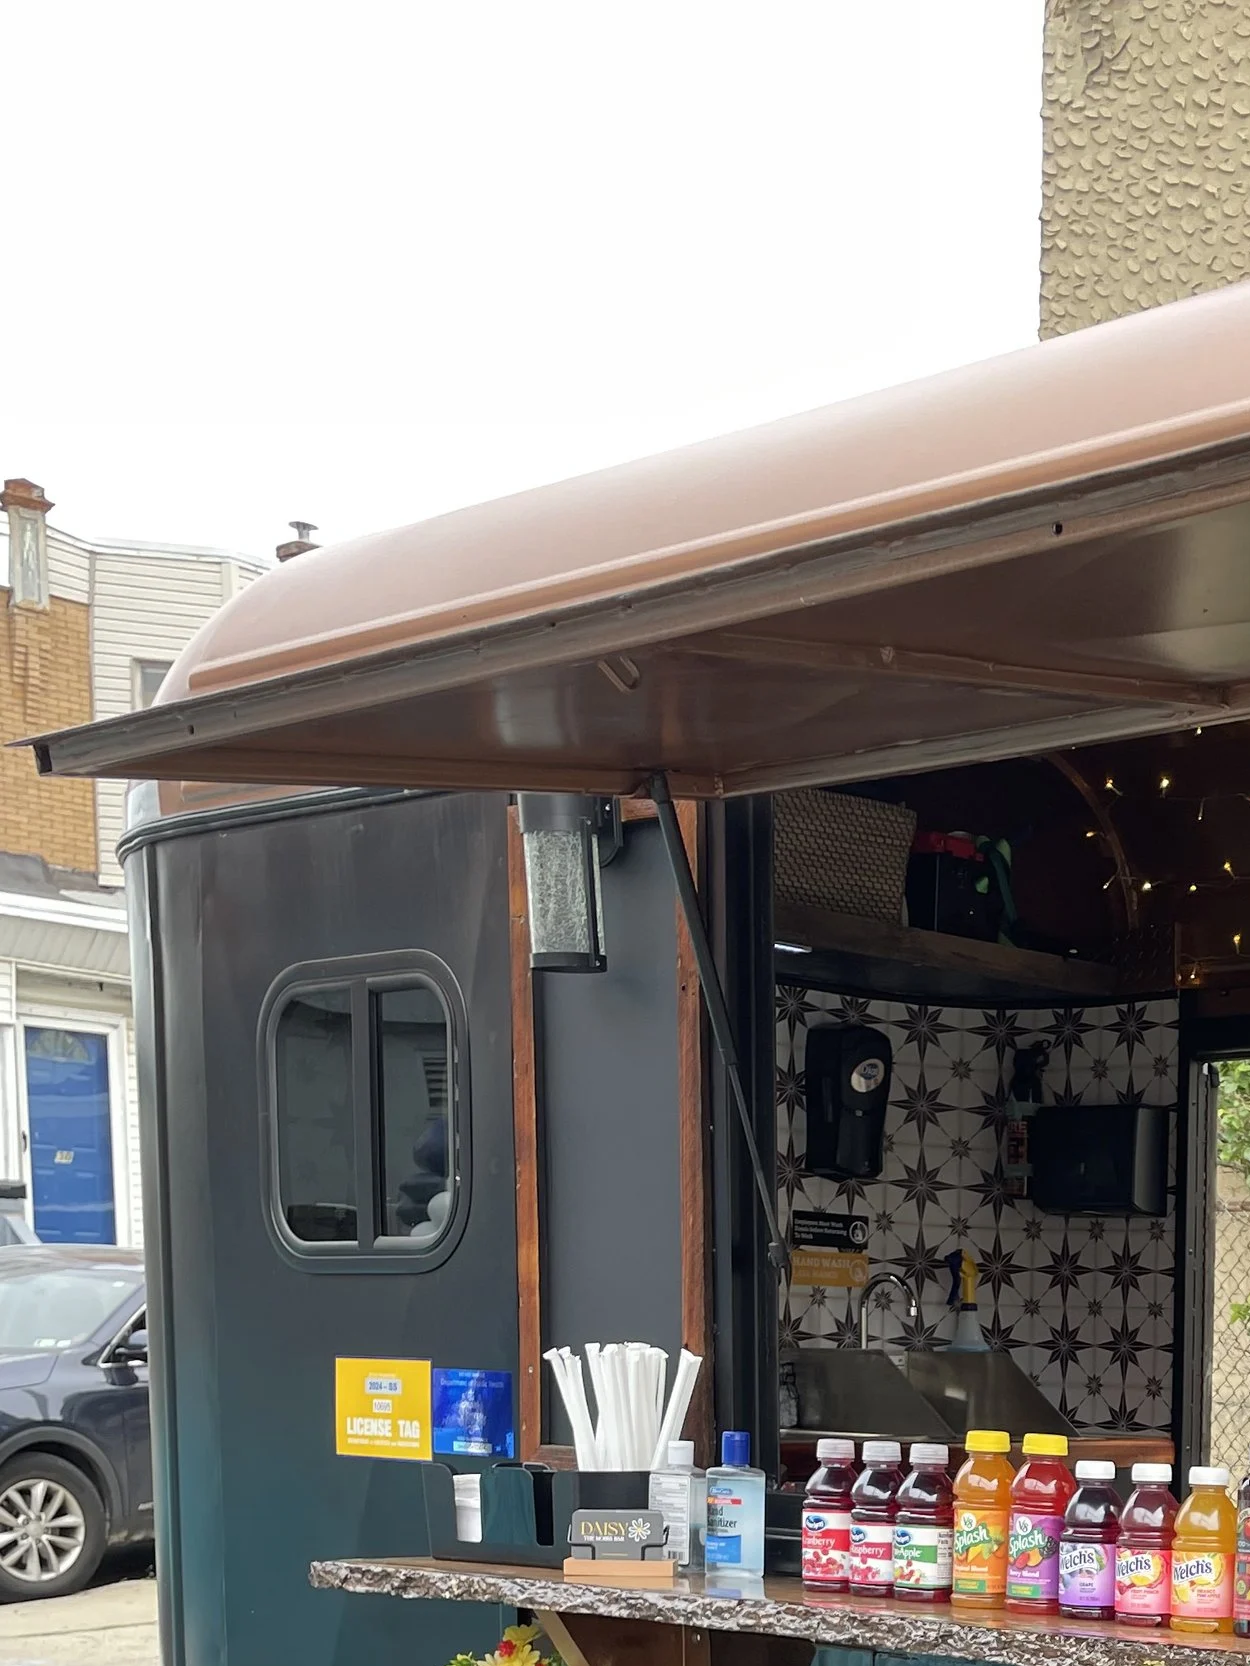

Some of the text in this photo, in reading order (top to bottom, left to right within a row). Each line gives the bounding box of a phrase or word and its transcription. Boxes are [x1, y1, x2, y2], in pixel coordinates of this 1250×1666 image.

[346, 1416, 420, 1439] LICENSE TAG
[581, 1521, 629, 1536] DAISY
[954, 1525, 990, 1553] Splash
[1009, 1528, 1046, 1558] Splash
